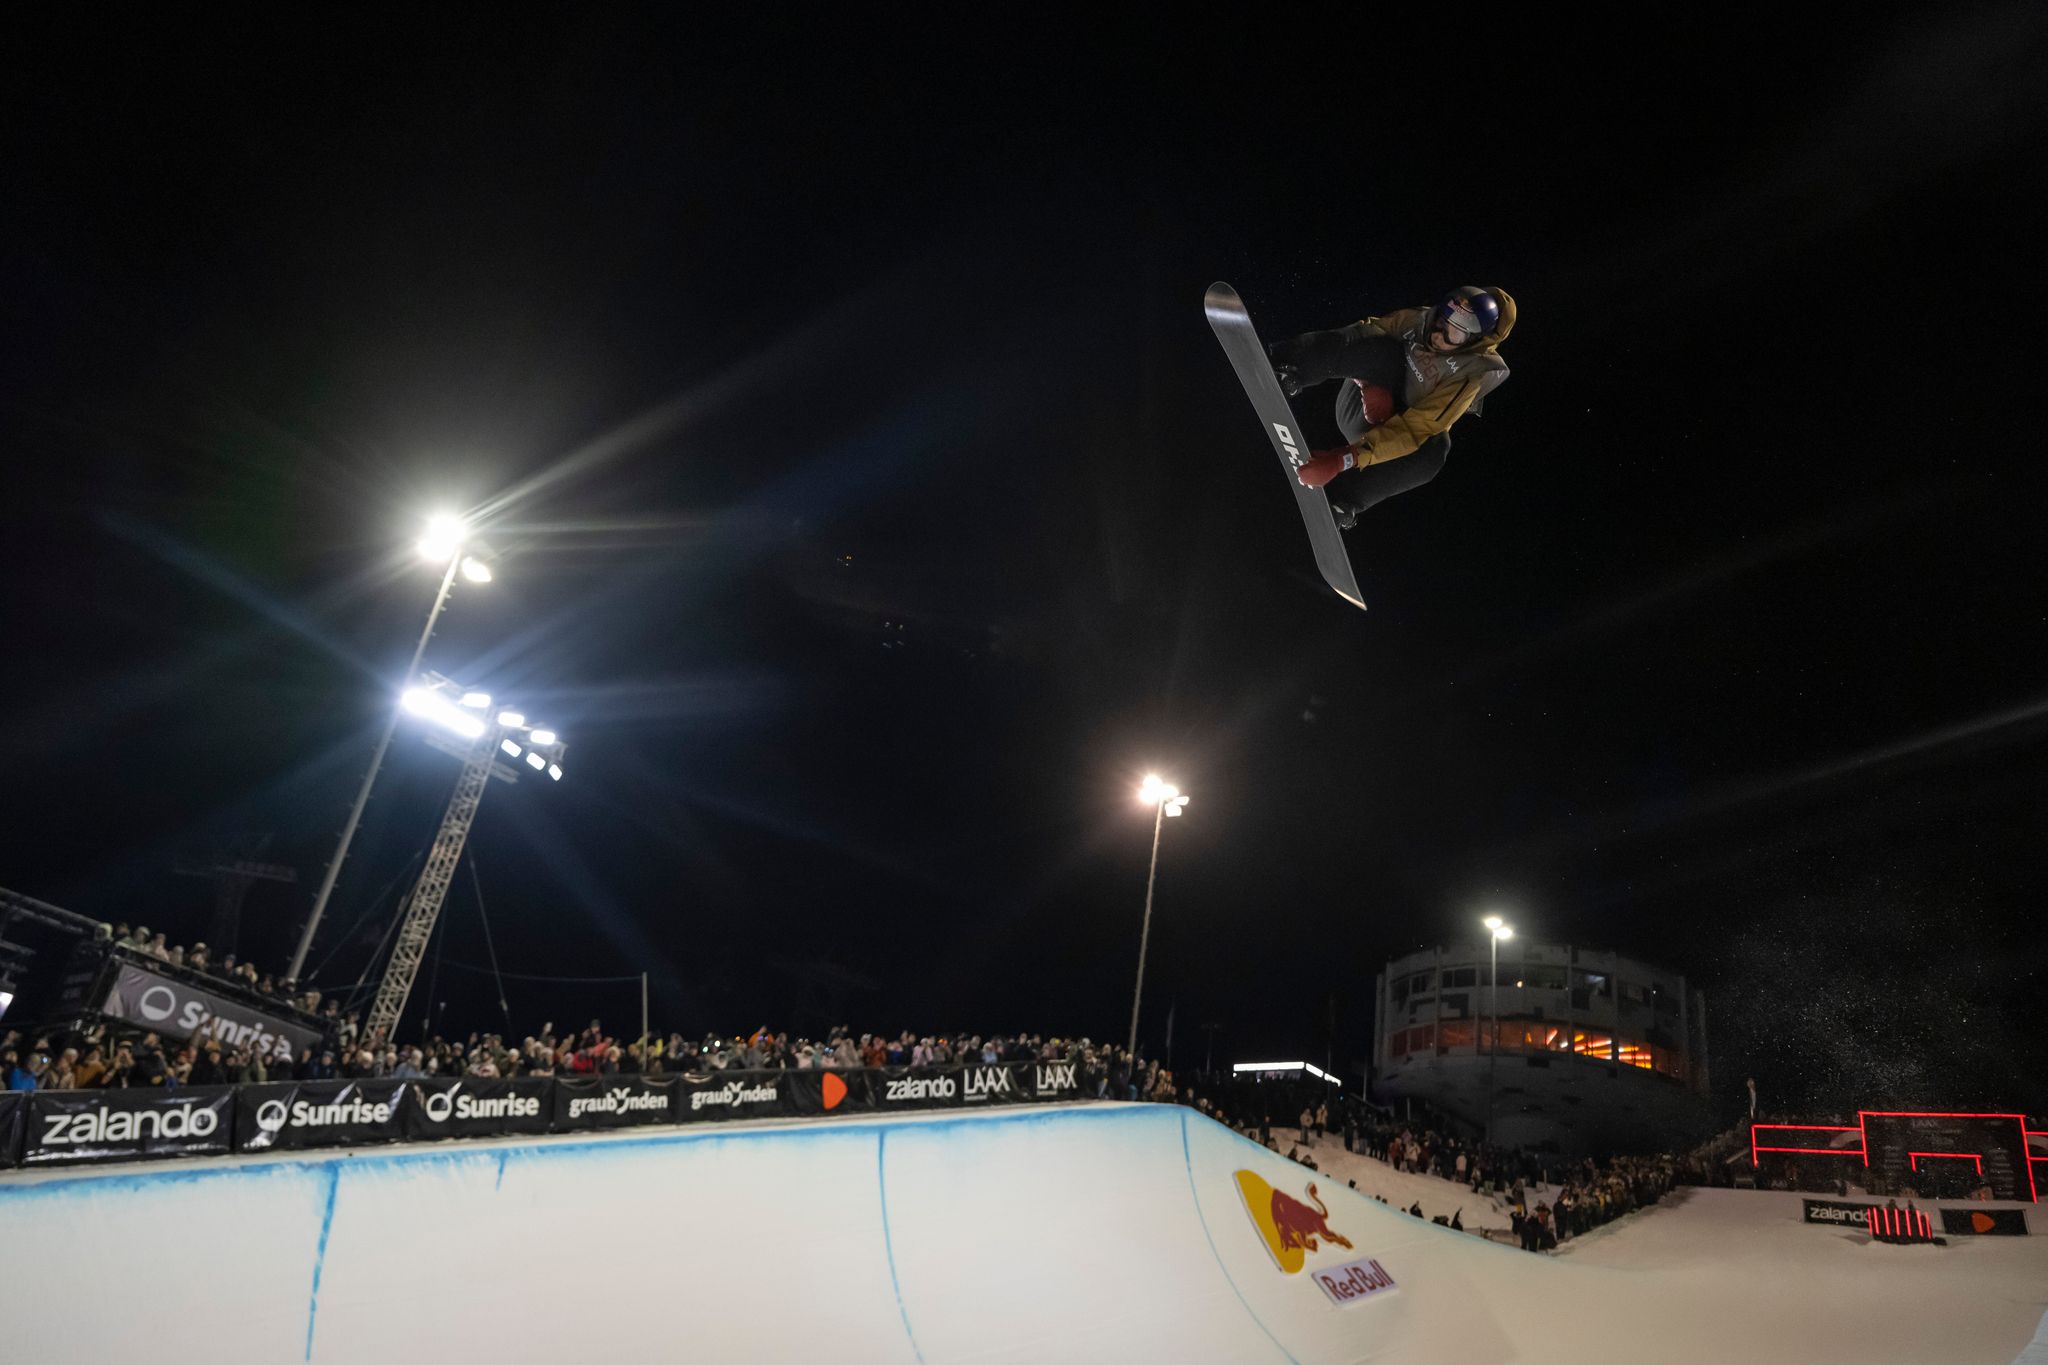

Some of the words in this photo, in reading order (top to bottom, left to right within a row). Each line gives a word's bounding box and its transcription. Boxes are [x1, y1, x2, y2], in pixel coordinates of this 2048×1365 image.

[886, 1075, 956, 1100] zalando
[963, 1066, 1012, 1095] LAAX
[1036, 1063, 1078, 1089] LAAX
[290, 1097, 391, 1127] Sunrise
[455, 1091, 540, 1118] Sunrise
[41, 1103, 218, 1145] zalando
